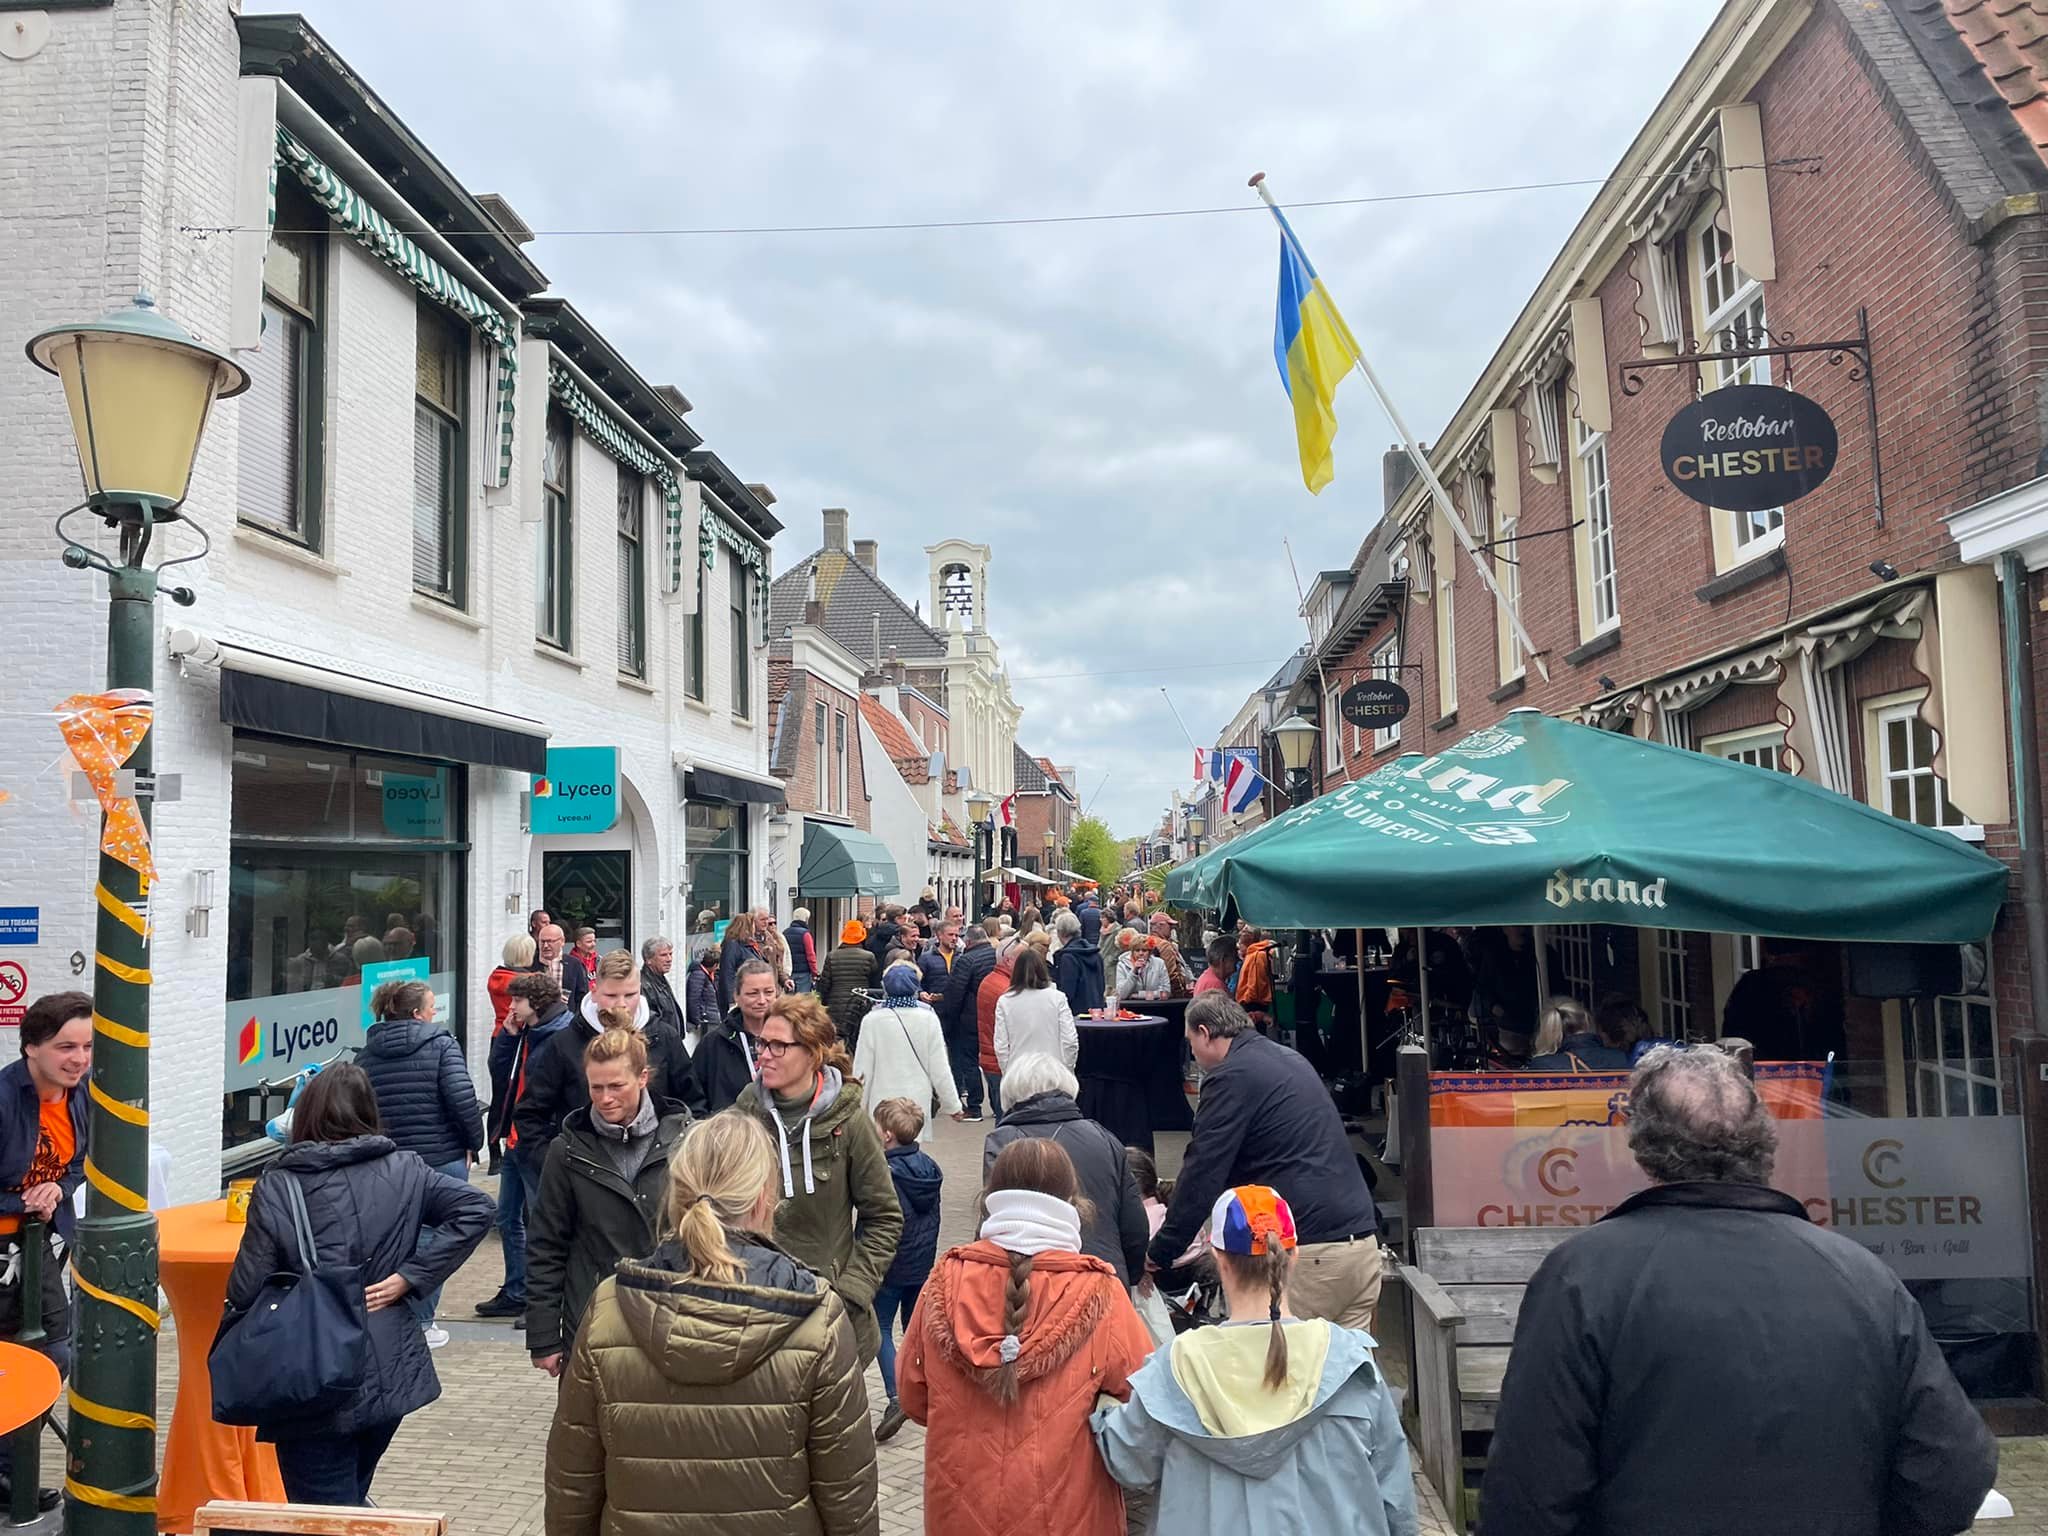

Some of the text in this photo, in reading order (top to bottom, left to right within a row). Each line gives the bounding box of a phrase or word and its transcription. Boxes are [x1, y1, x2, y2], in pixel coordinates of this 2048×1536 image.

[1700, 415, 1794, 442] Restobar
[1672, 445, 1825, 480] CHESTER
[1344, 704, 1405, 717] CHESTER
[558, 781, 612, 800] Lyceo
[557, 814, 592, 822] Lyceo.nl
[1545, 868, 1668, 909] Brand
[70, 950, 86, 976] 9
[272, 1017, 339, 1064] Lyceo
[1477, 1205, 1615, 1227] CHEST
[1804, 1196, 1983, 1227] CHESTER
